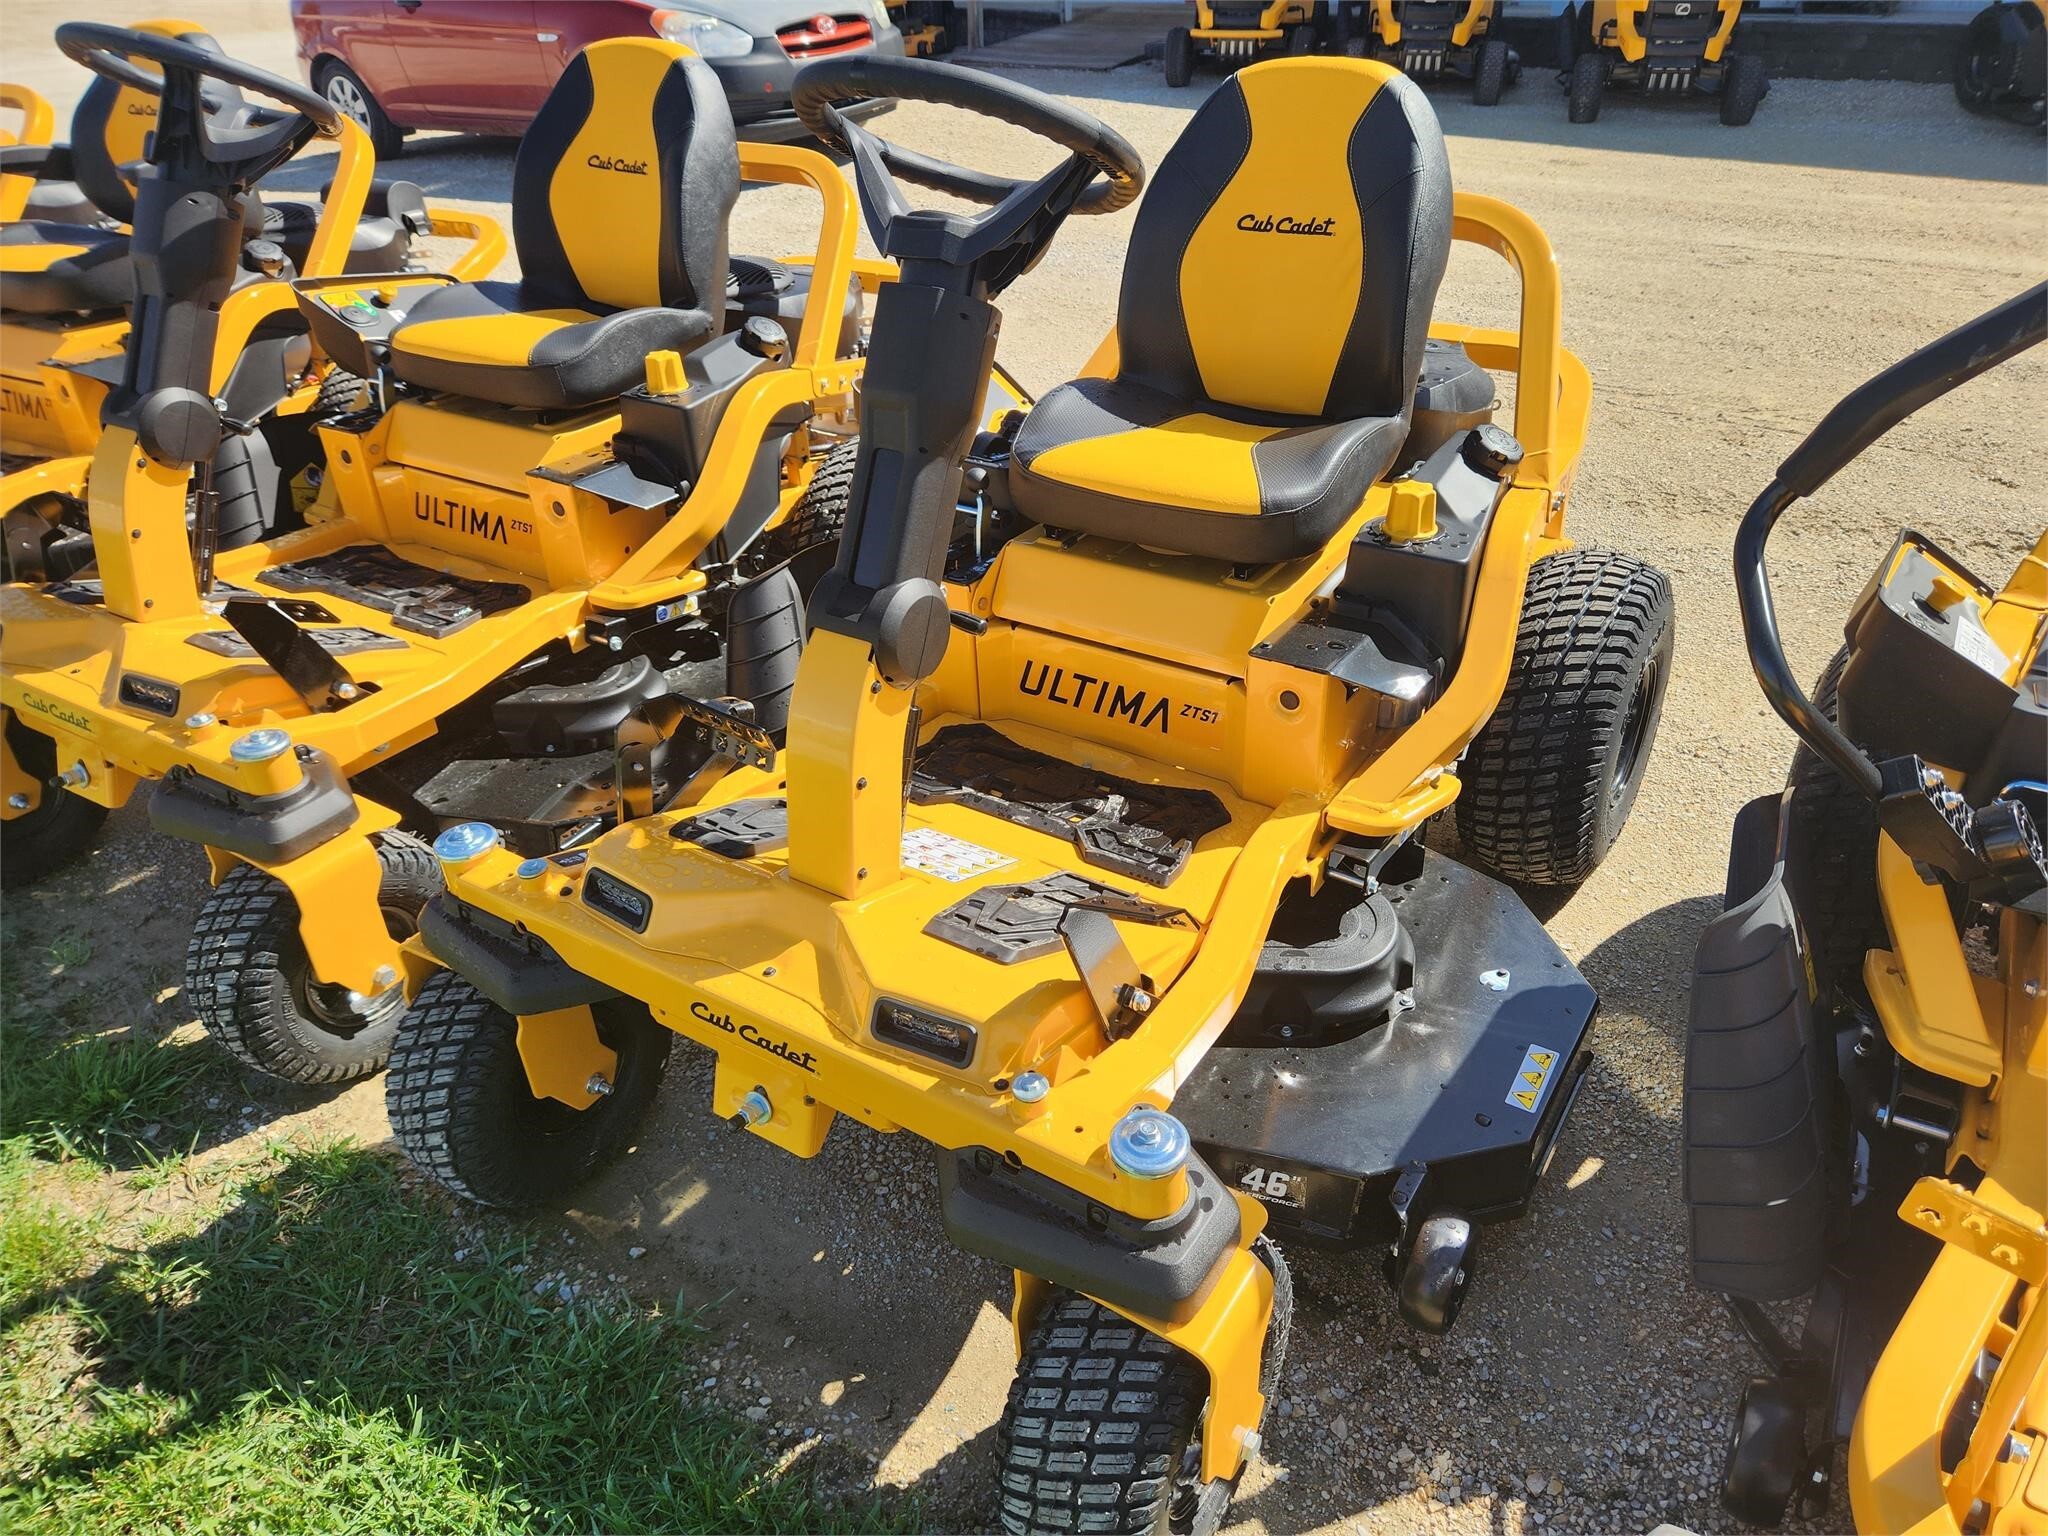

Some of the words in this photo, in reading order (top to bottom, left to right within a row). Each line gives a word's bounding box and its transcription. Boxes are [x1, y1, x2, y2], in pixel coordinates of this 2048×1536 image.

[588, 155, 612, 170] Cub
[614, 159, 648, 175] Cadet
[1237, 214, 1274, 232] Cub
[1276, 217, 1335, 236] Cadet
[416, 492, 507, 544] ULTIMA
[511, 519, 532, 534] ZTS1
[23, 693, 48, 713] Cub
[49, 704, 94, 733] Cadet
[1019, 660, 1168, 734] ULTIMA
[1180, 704, 1218, 724] ZTS1
[690, 1002, 735, 1033] Cub
[739, 1025, 817, 1073] Cadet
